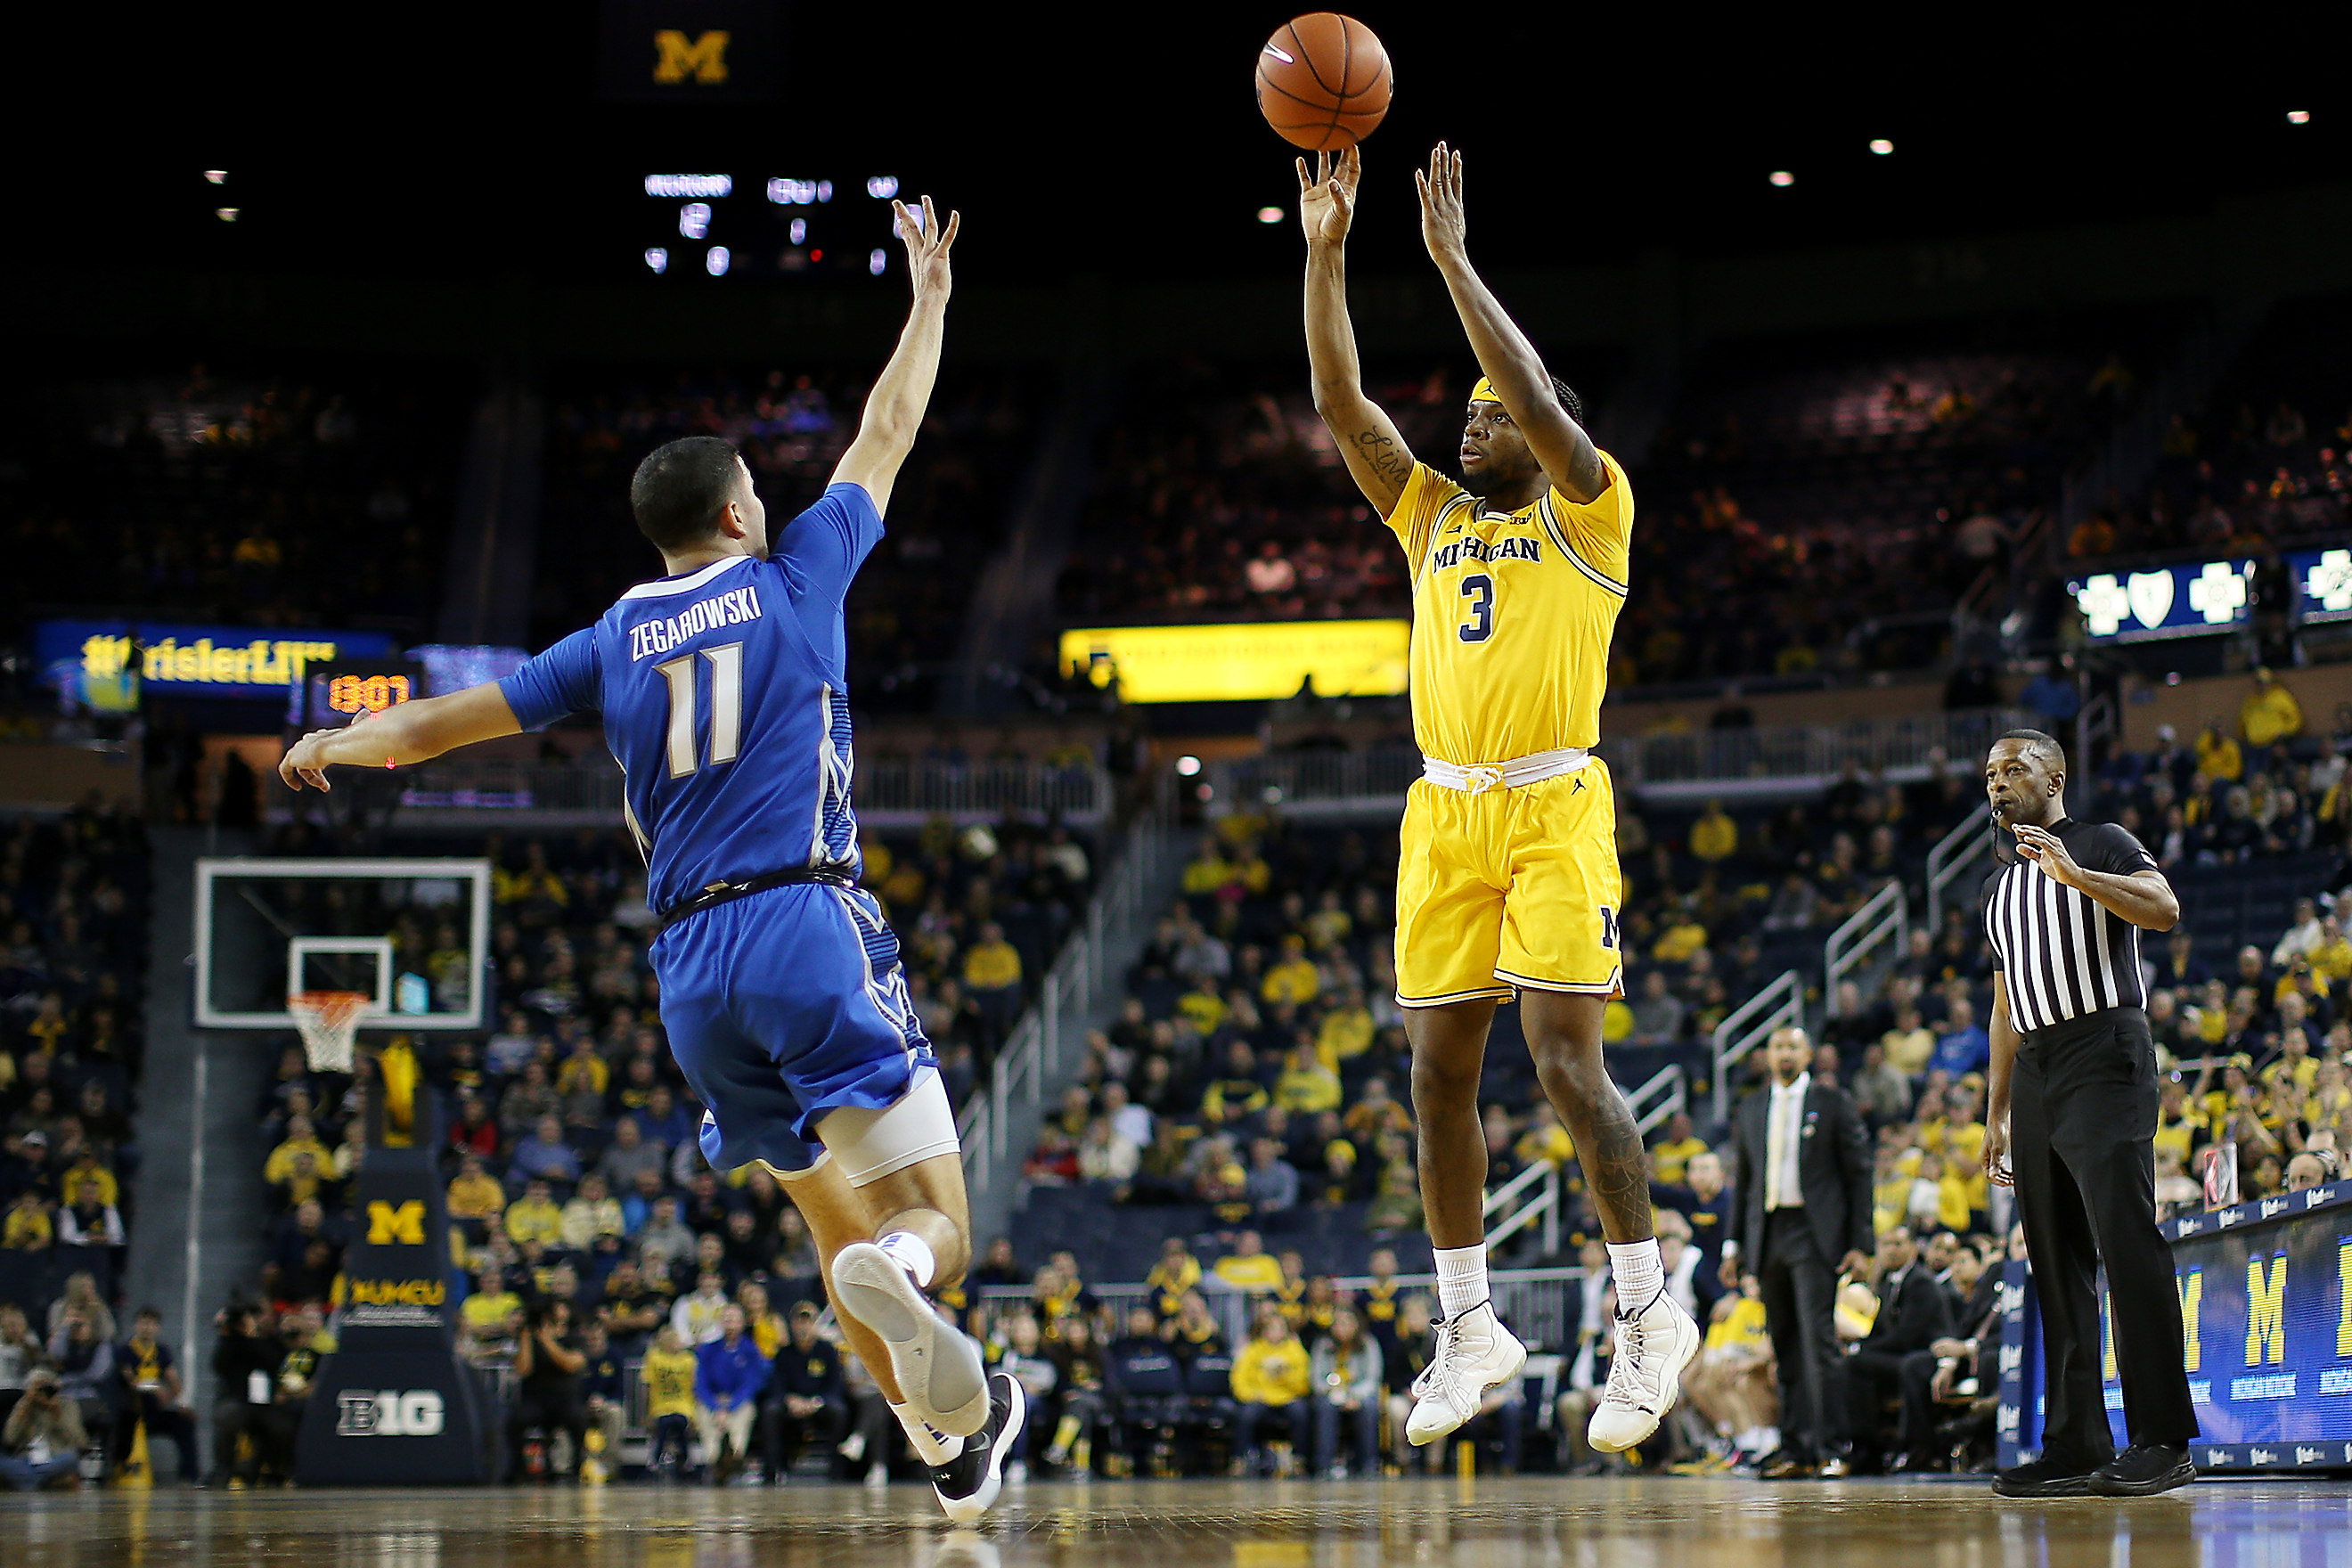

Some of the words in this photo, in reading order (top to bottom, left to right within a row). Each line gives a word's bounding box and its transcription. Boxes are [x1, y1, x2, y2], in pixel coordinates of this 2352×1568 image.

[654, 29, 729, 83] M
[1432, 536, 1542, 576] MIHIGAN
[629, 585, 763, 662] ZEGAROWSKI
[1459, 573, 1496, 644] 3
[651, 641, 744, 780] 11
[366, 1199, 426, 1245] M
[2244, 1254, 2289, 1366] M
